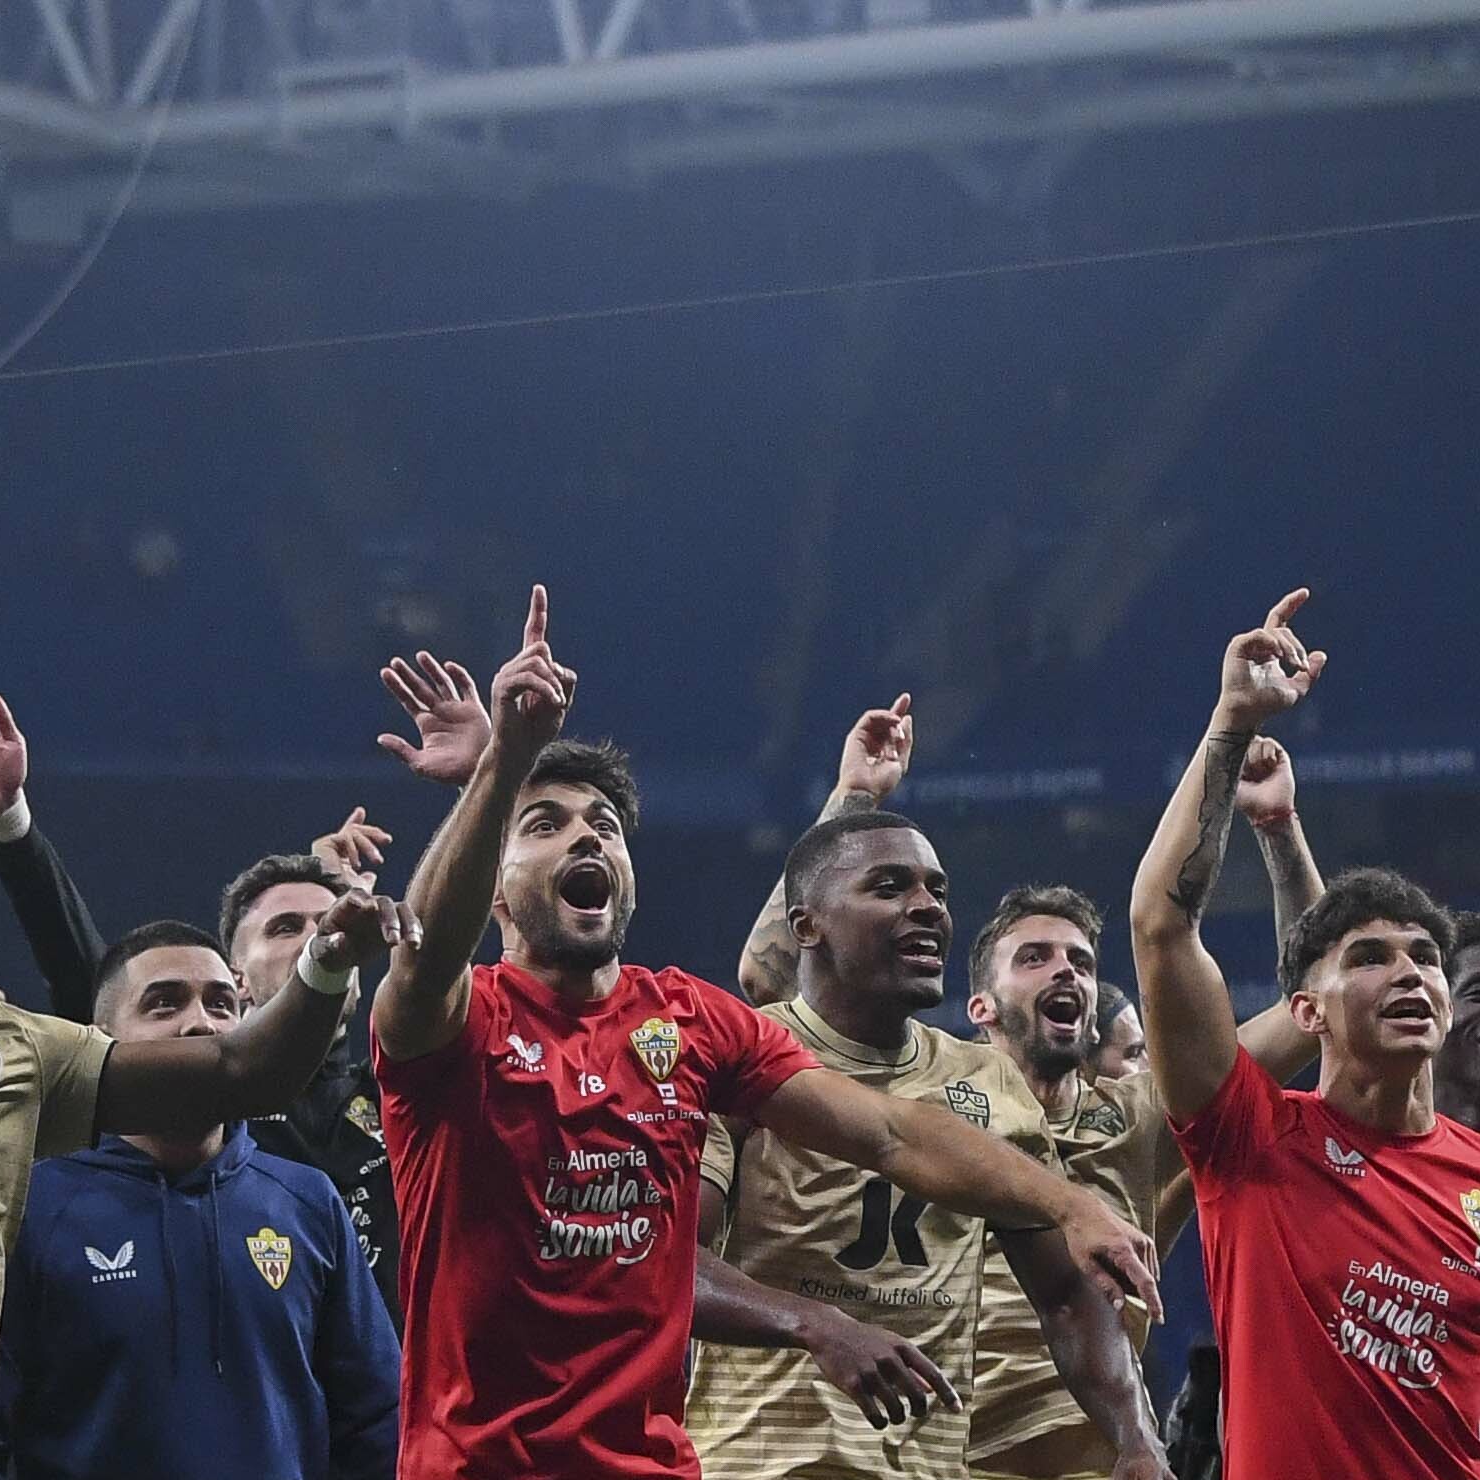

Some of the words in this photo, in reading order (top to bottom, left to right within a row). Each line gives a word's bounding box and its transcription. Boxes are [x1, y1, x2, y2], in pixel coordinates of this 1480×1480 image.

[577, 1071, 606, 1097] 18
[547, 1155, 565, 1172] En
[566, 1145, 648, 1173] Almería
[571, 1171, 639, 1214] vida
[92, 1270, 137, 1284] CASTORE
[799, 1277, 868, 1301] Khaled
[932, 1288, 956, 1306] Co.
[1347, 1259, 1367, 1277] En
[1366, 1261, 1450, 1307] Almería
[1366, 1294, 1434, 1338] vida
